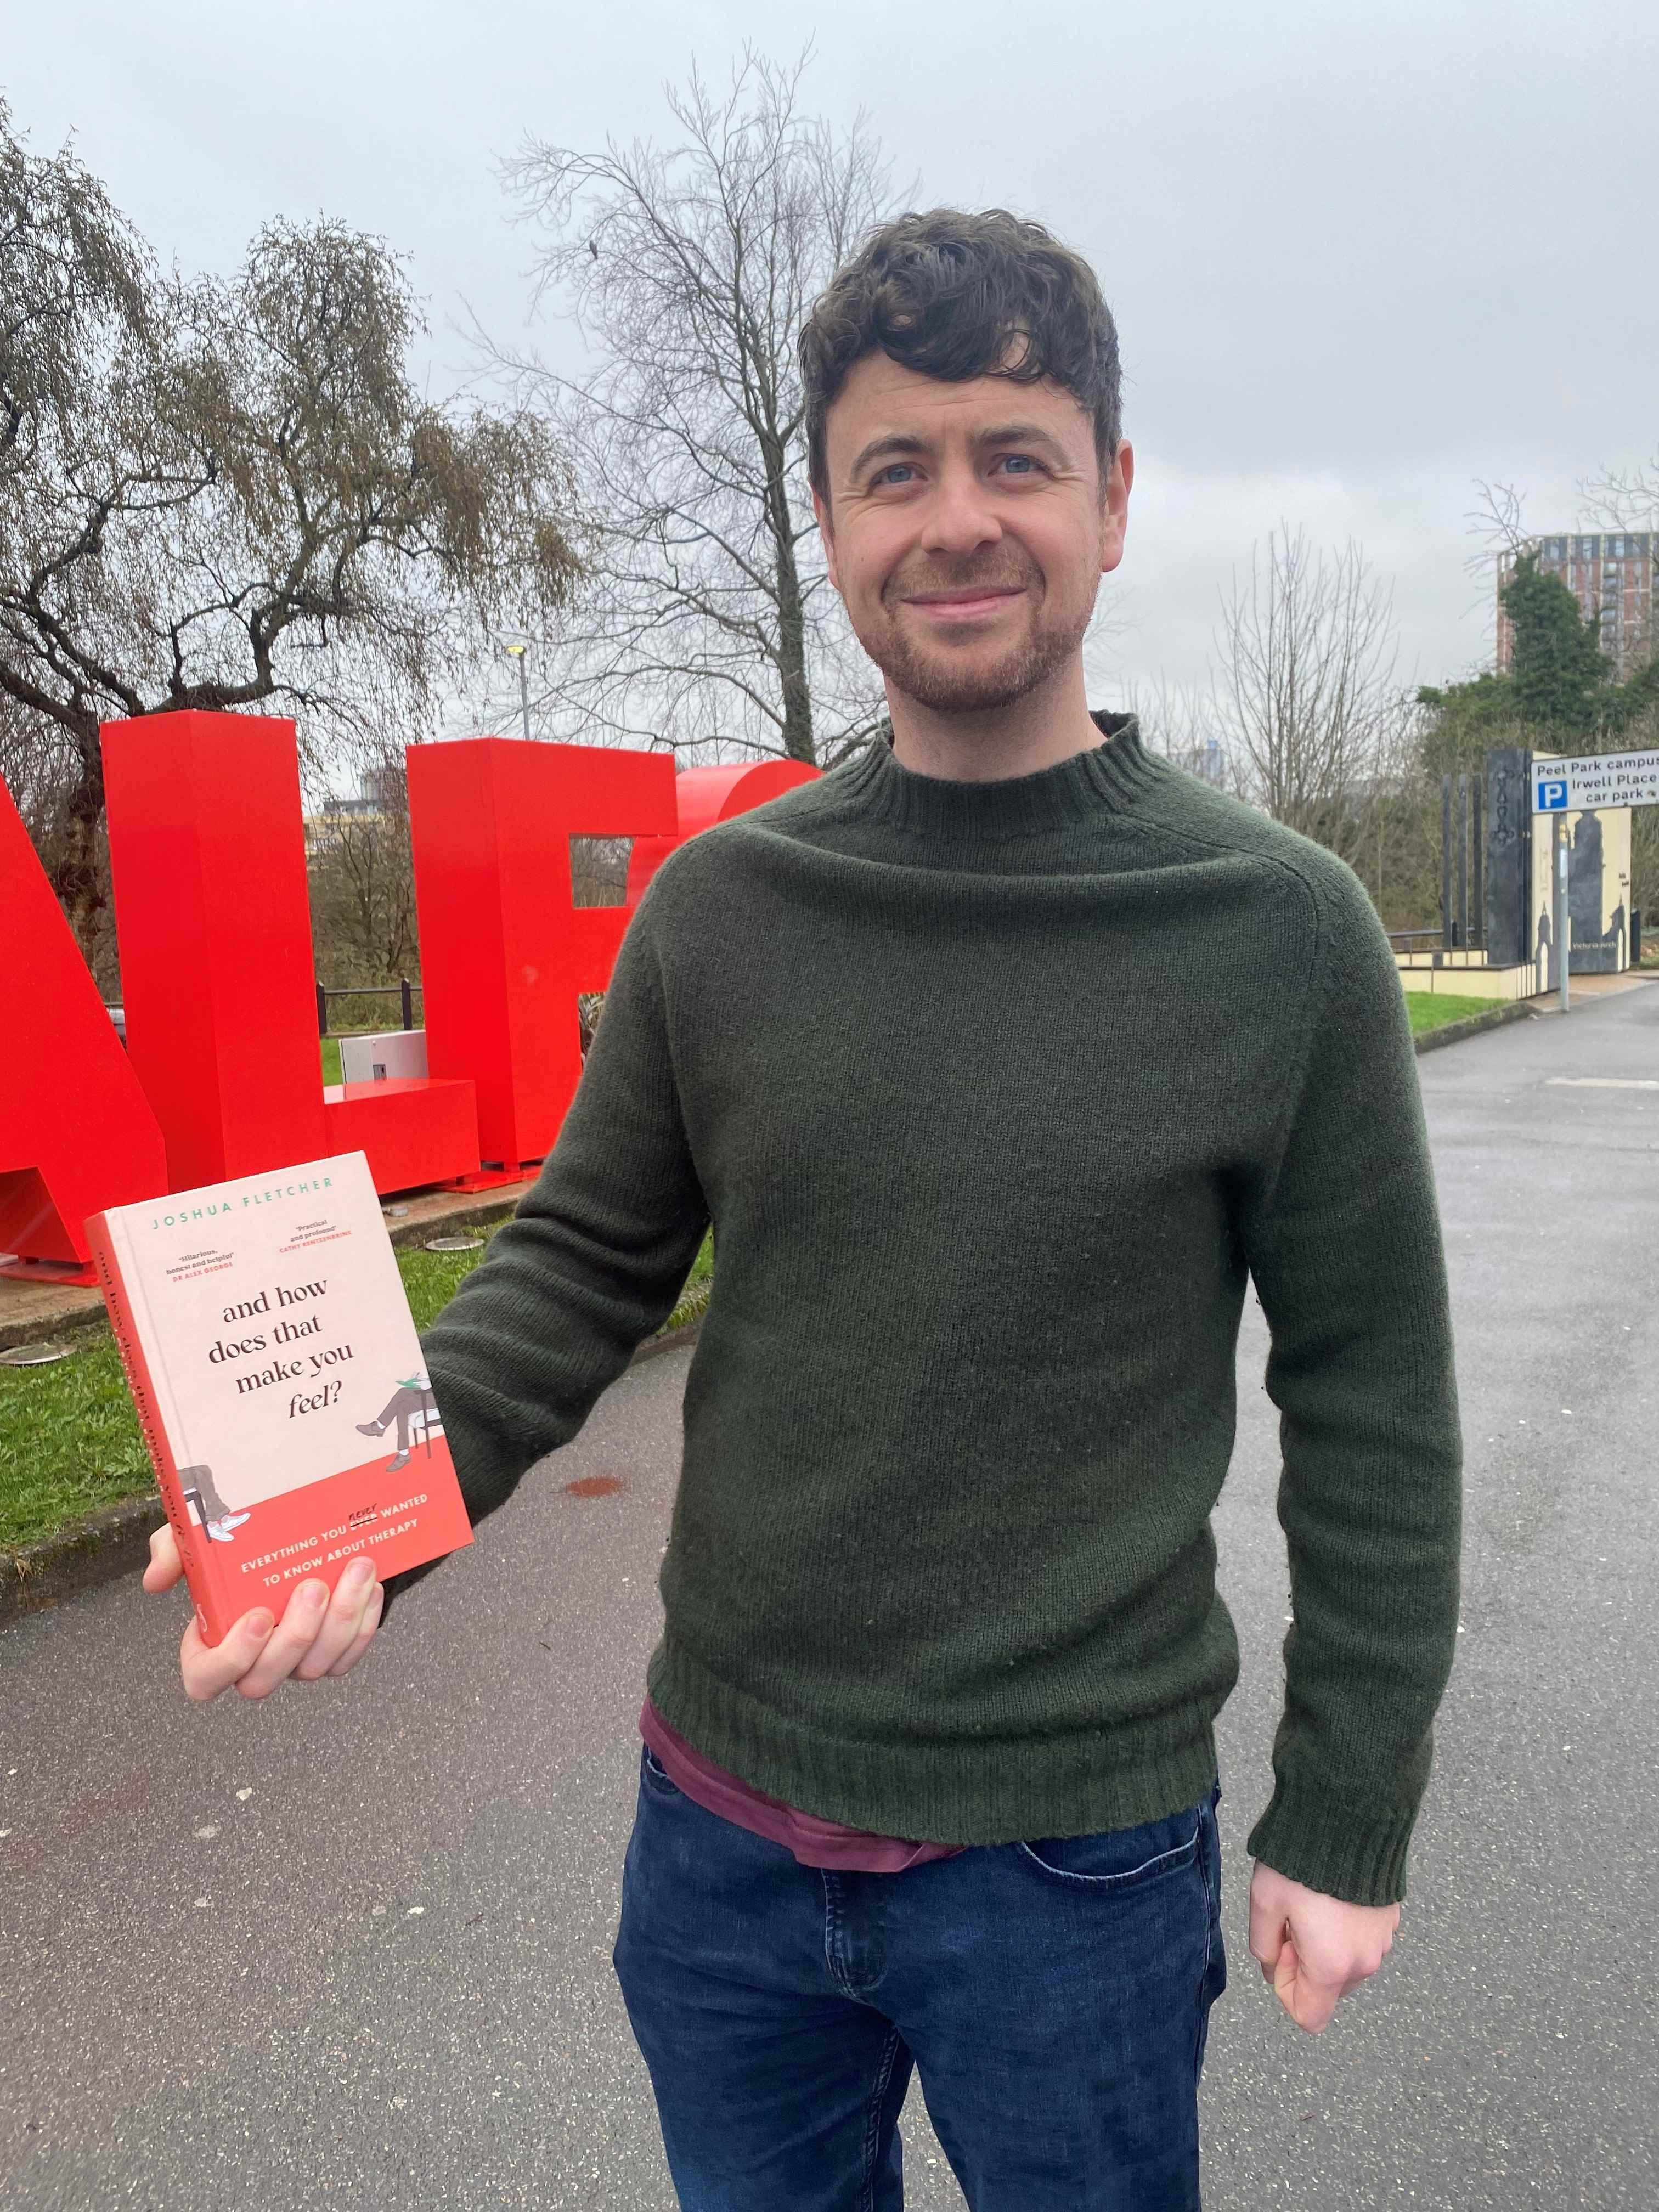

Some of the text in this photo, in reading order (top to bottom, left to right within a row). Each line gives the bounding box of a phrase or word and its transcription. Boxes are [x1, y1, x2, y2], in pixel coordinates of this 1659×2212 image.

[1537, 764, 1566, 776] Peel
[1571, 760, 1601, 772] Park
[1572, 774, 1657, 789] Irwell Place
[1544, 784, 1563, 808] P
[1586, 788, 1643, 803] car park
[153, 1178, 332, 1229] JOSHUA FLETCHER
[279, 1243, 301, 1254] CATHY
[290, 1234, 303, 1242] and
[166, 1263, 191, 1275] honest
[192, 1259, 206, 1269] and
[172, 1262, 233, 1282] DR ALEX GEORGE
[223, 1280, 328, 1323] and how
[208, 1314, 323, 1363] does that
[235, 1345, 354, 1394] make you
[289, 1380, 342, 1418] feel?
[348, 1503, 377, 1521] never
[241, 1536, 318, 1573] EVERYTHING
[321, 1525, 347, 1542] YOU
[380, 1494, 428, 1519] WANTED
[263, 1518, 418, 1587] TO KNOW ABOUT THERAPY
